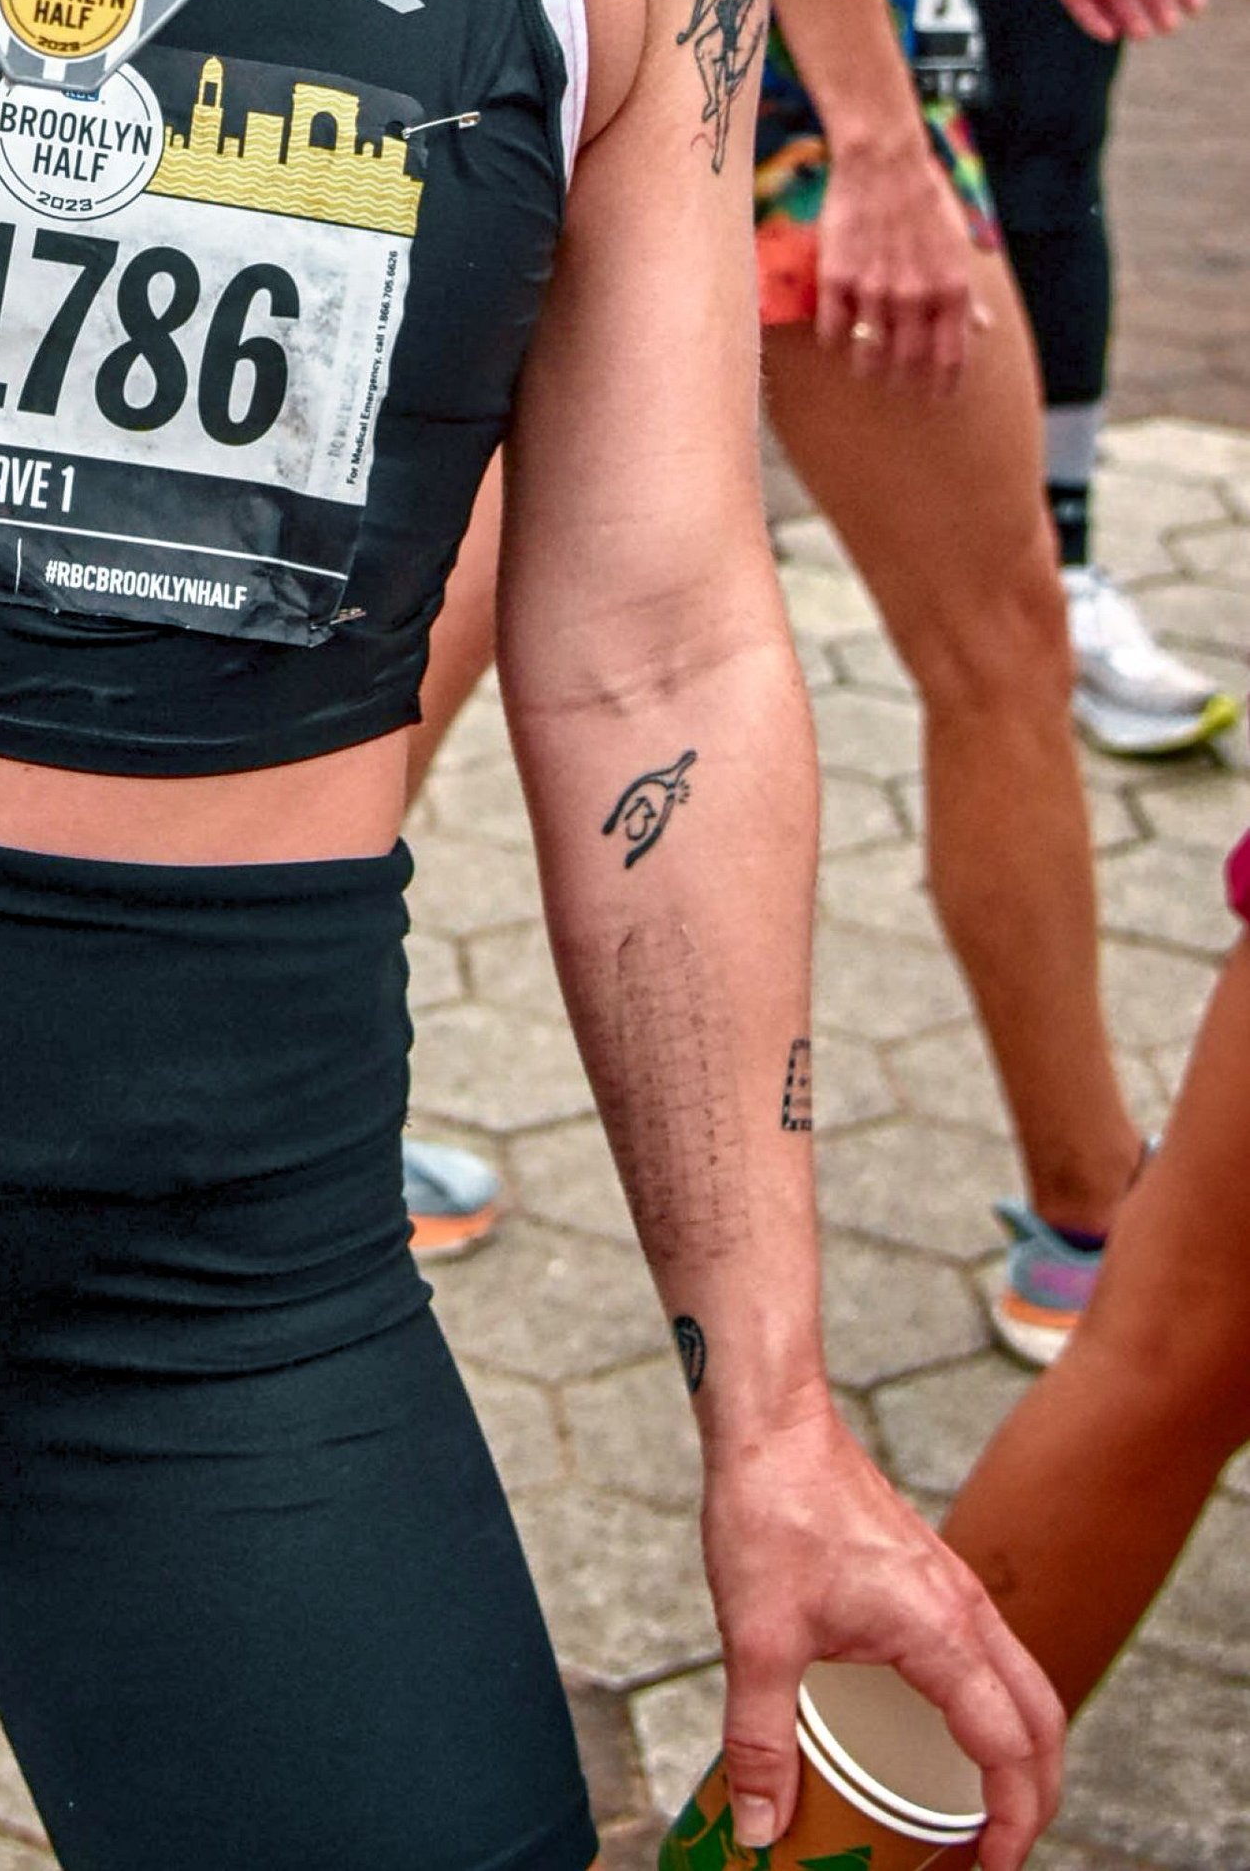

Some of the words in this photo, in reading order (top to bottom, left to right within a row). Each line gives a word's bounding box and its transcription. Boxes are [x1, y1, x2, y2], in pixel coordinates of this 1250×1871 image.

[33, 0, 93, 30] HALF
[32, 142, 110, 183] HALF
[35, 191, 94, 212] 2023
[374, 334, 386, 354] call
[350, 422, 369, 465] Medical
[60, 464, 76, 513] 1
[345, 467, 359, 485] For
[44, 559, 249, 612] #RBCBROOKLYNHALF
